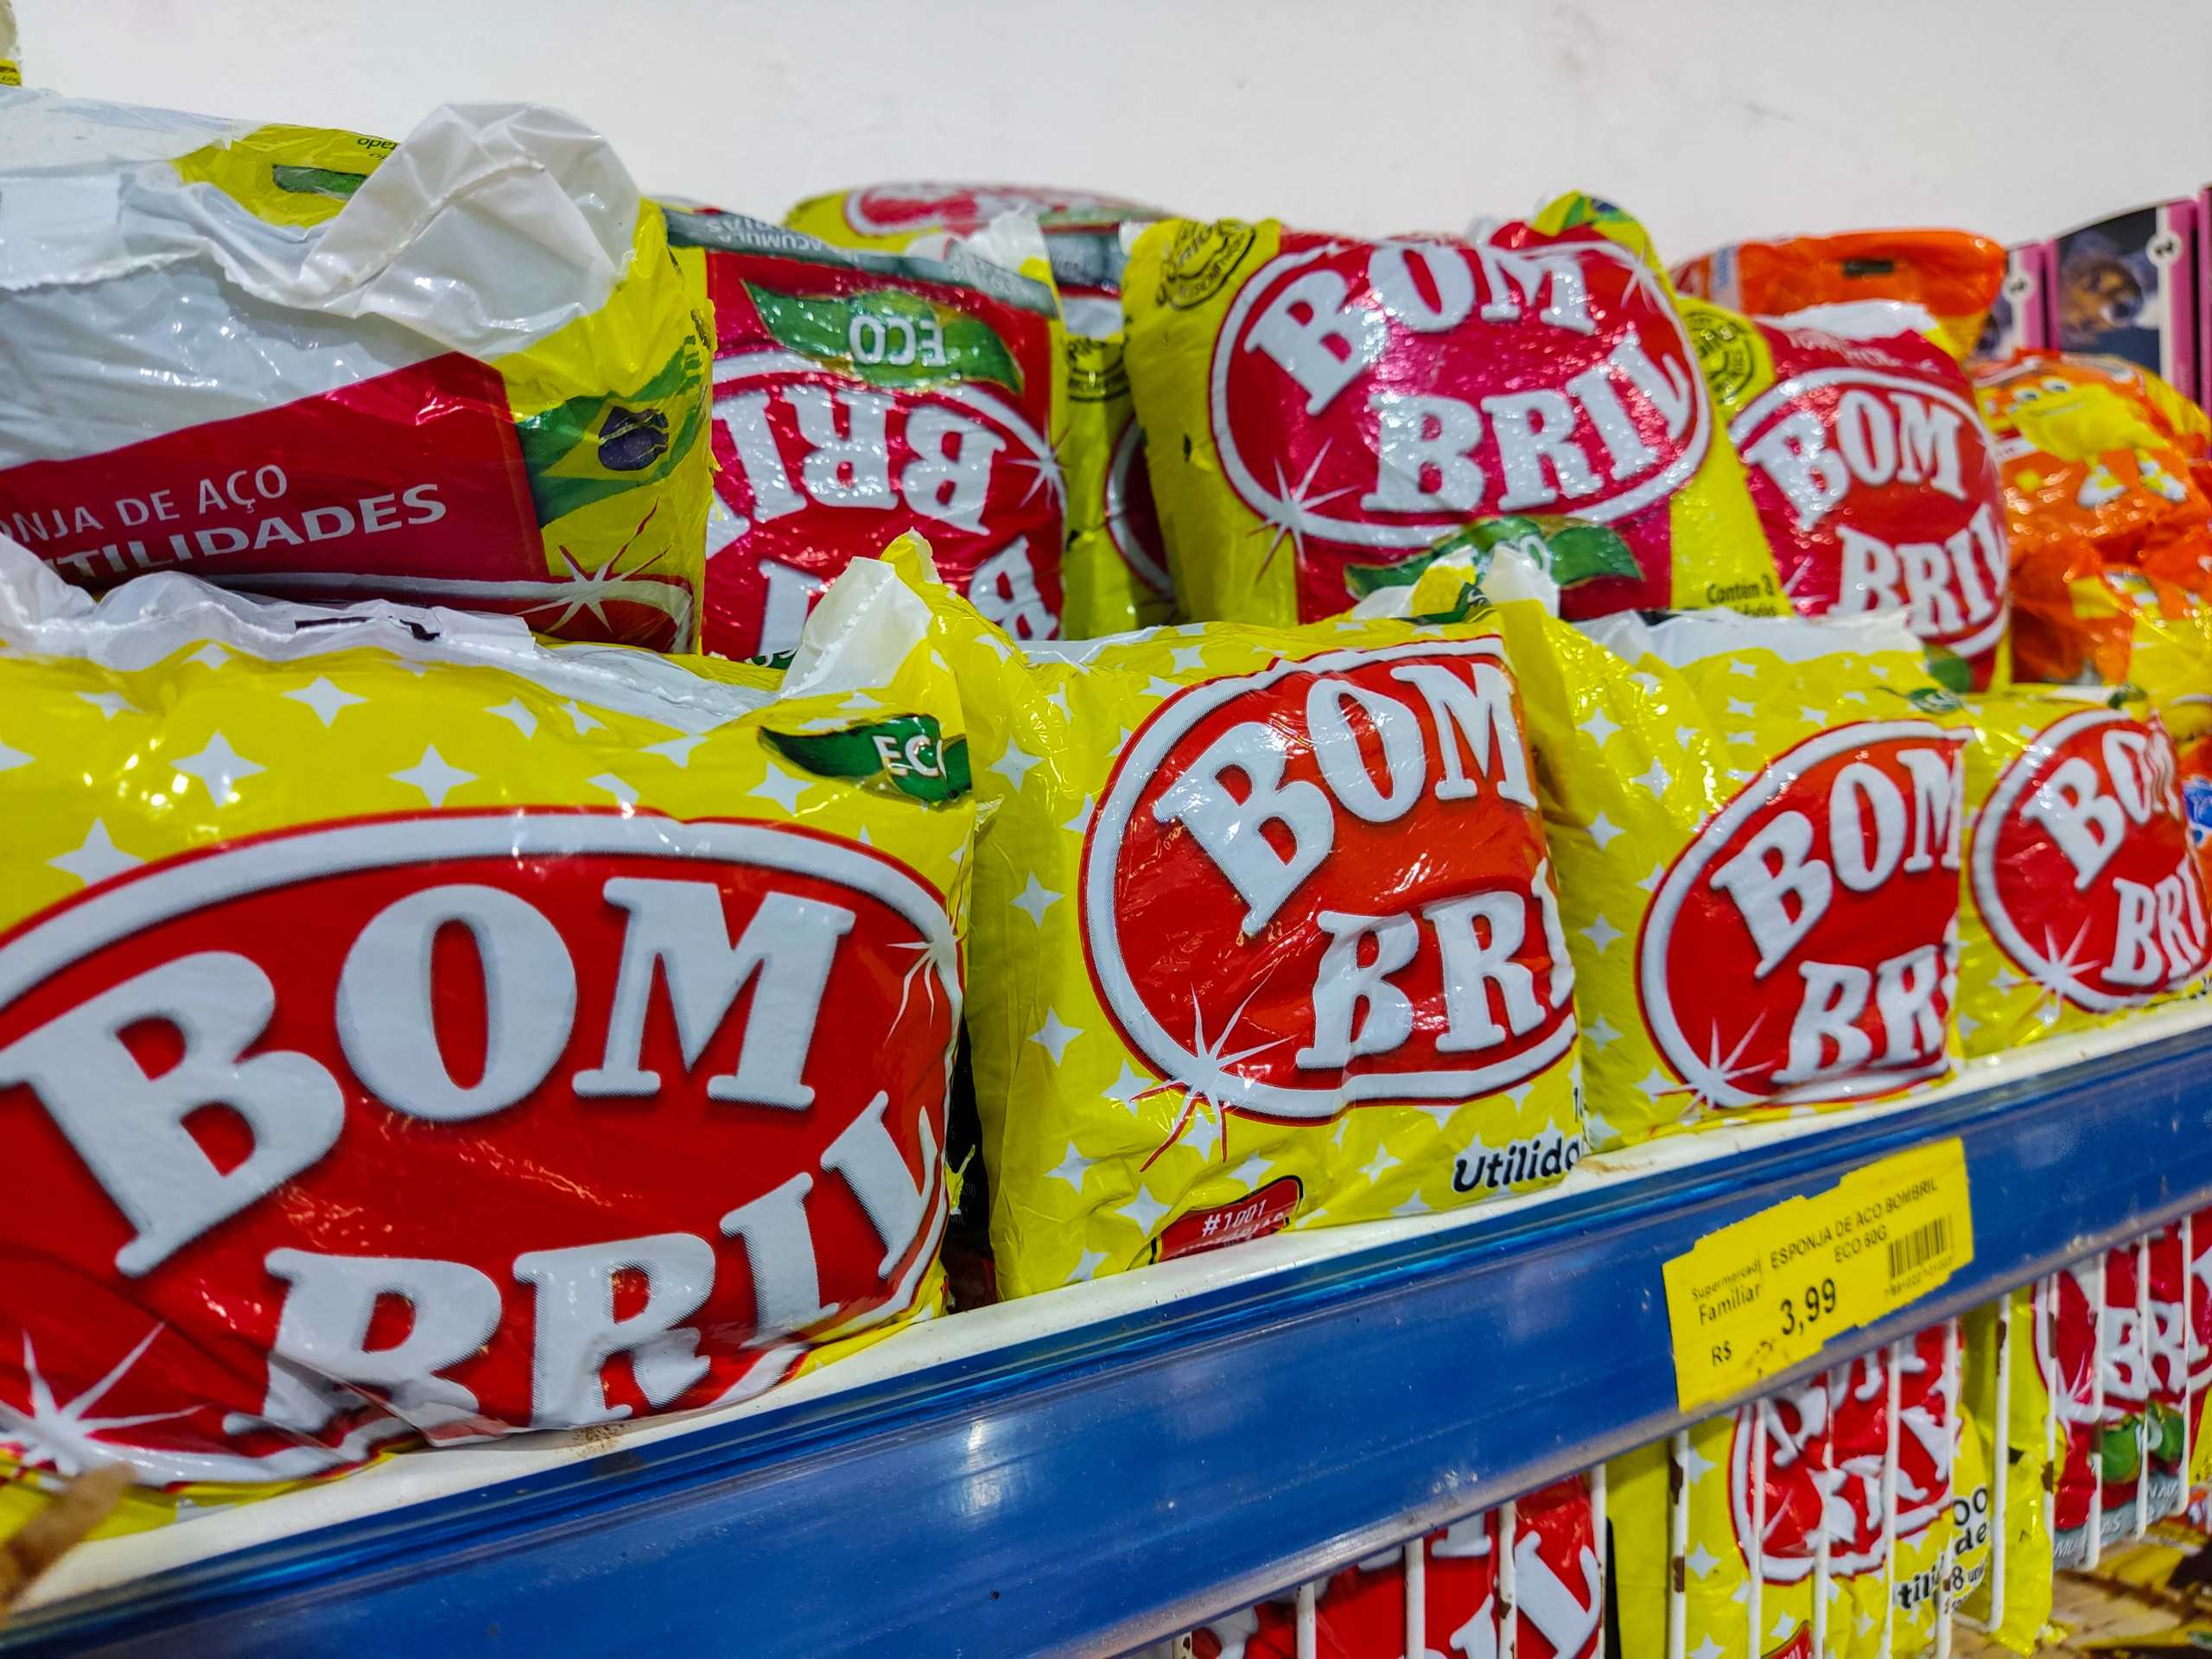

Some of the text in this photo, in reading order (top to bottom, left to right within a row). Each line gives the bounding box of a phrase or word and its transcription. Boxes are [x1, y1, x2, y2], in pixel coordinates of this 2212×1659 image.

[849, 313, 948, 366] ECO
[1244, 242, 1597, 417] BOM
[1360, 330, 1690, 514] BRIL
[1748, 390, 1967, 530] BOM
[115, 489, 180, 526] DE
[198, 464, 288, 514] AÇO
[1154, 664, 1537, 937] BOM
[1711, 747, 1963, 980] BOM
[0, 876, 855, 1277] BOM
[1202, 1198, 1268, 1237] #1001
[1770, 1226, 1833, 1269] ESPONJA
[1835, 1216, 1853, 1237] DE
[1885, 1178, 1938, 1214] BOMBRIL
[1834, 1238, 1861, 1262] ECO
[223, 1091, 939, 1446] BRIL
[1699, 1283, 1762, 1325] Familiar
[1712, 1277, 1837, 1366] R$ 3,99
[1952, 1566, 1965, 1591] 8
